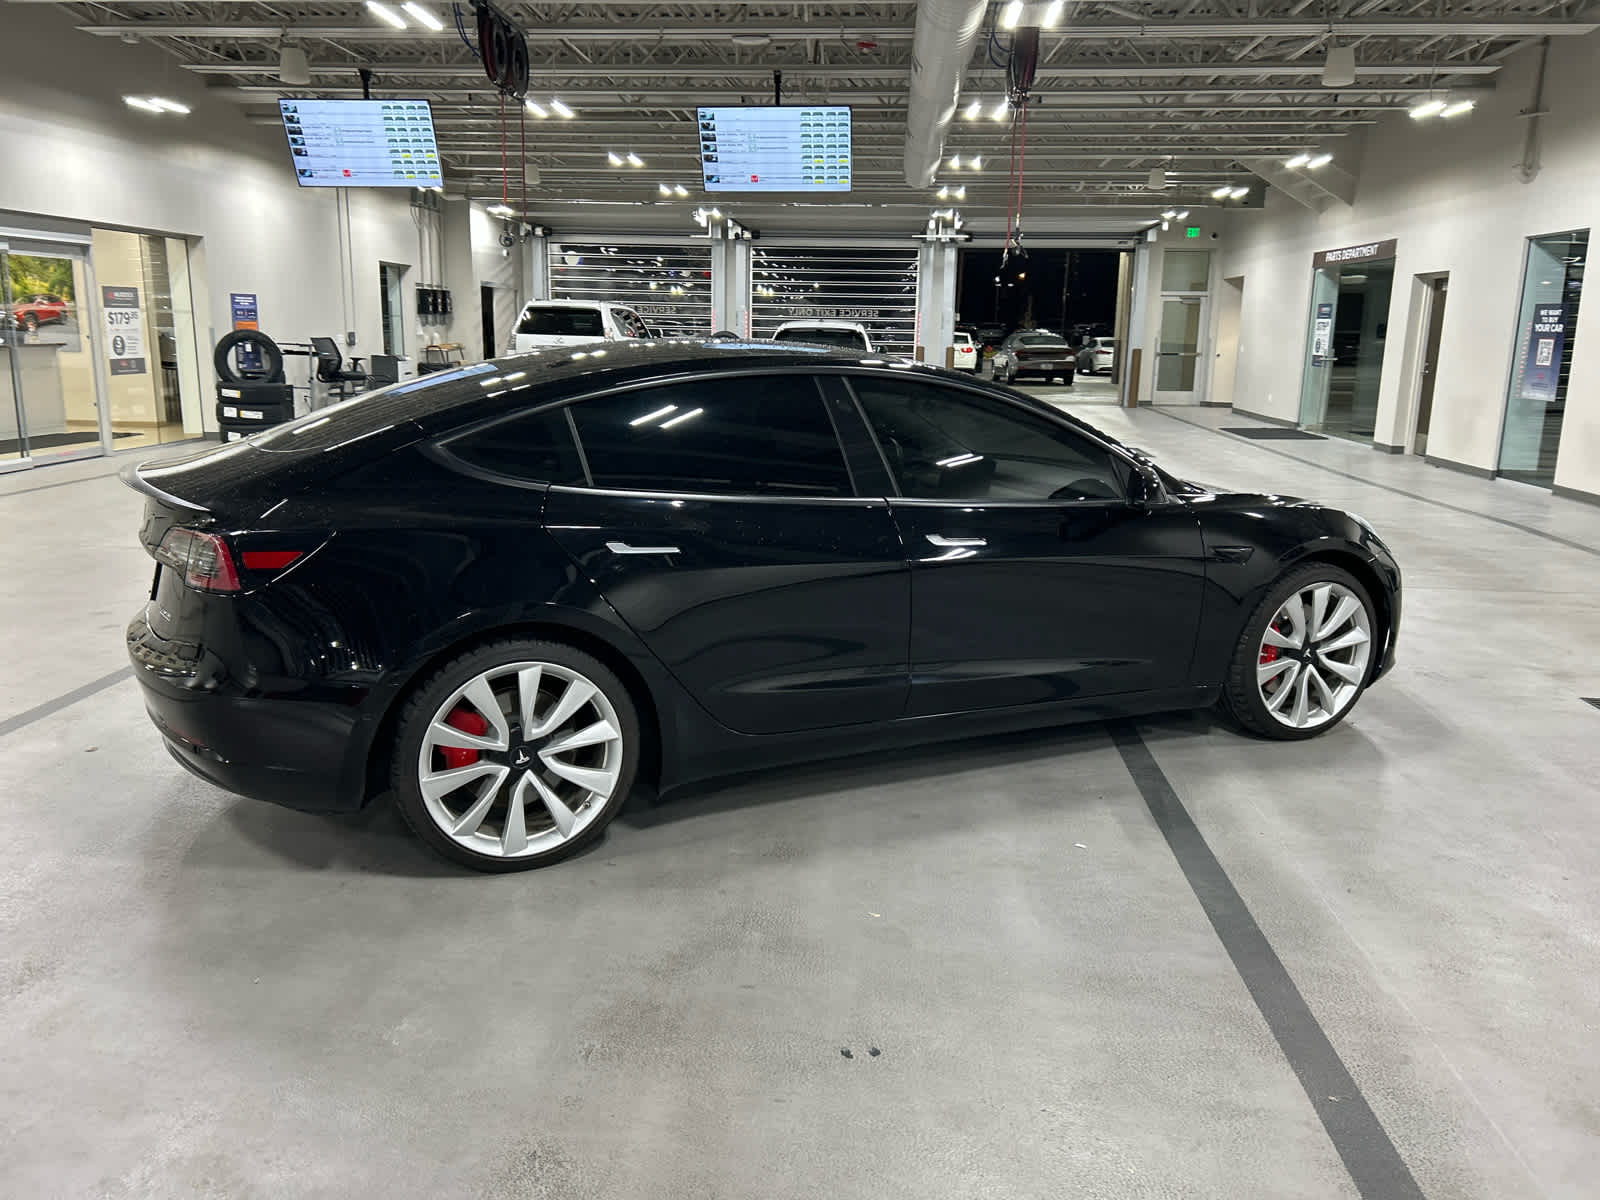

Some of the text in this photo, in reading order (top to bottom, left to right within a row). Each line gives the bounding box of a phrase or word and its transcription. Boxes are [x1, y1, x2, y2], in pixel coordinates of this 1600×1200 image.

[1325, 244, 1379, 262] PARTS DEPARTMENT
[1535, 324, 1564, 332] YOUR CAR
